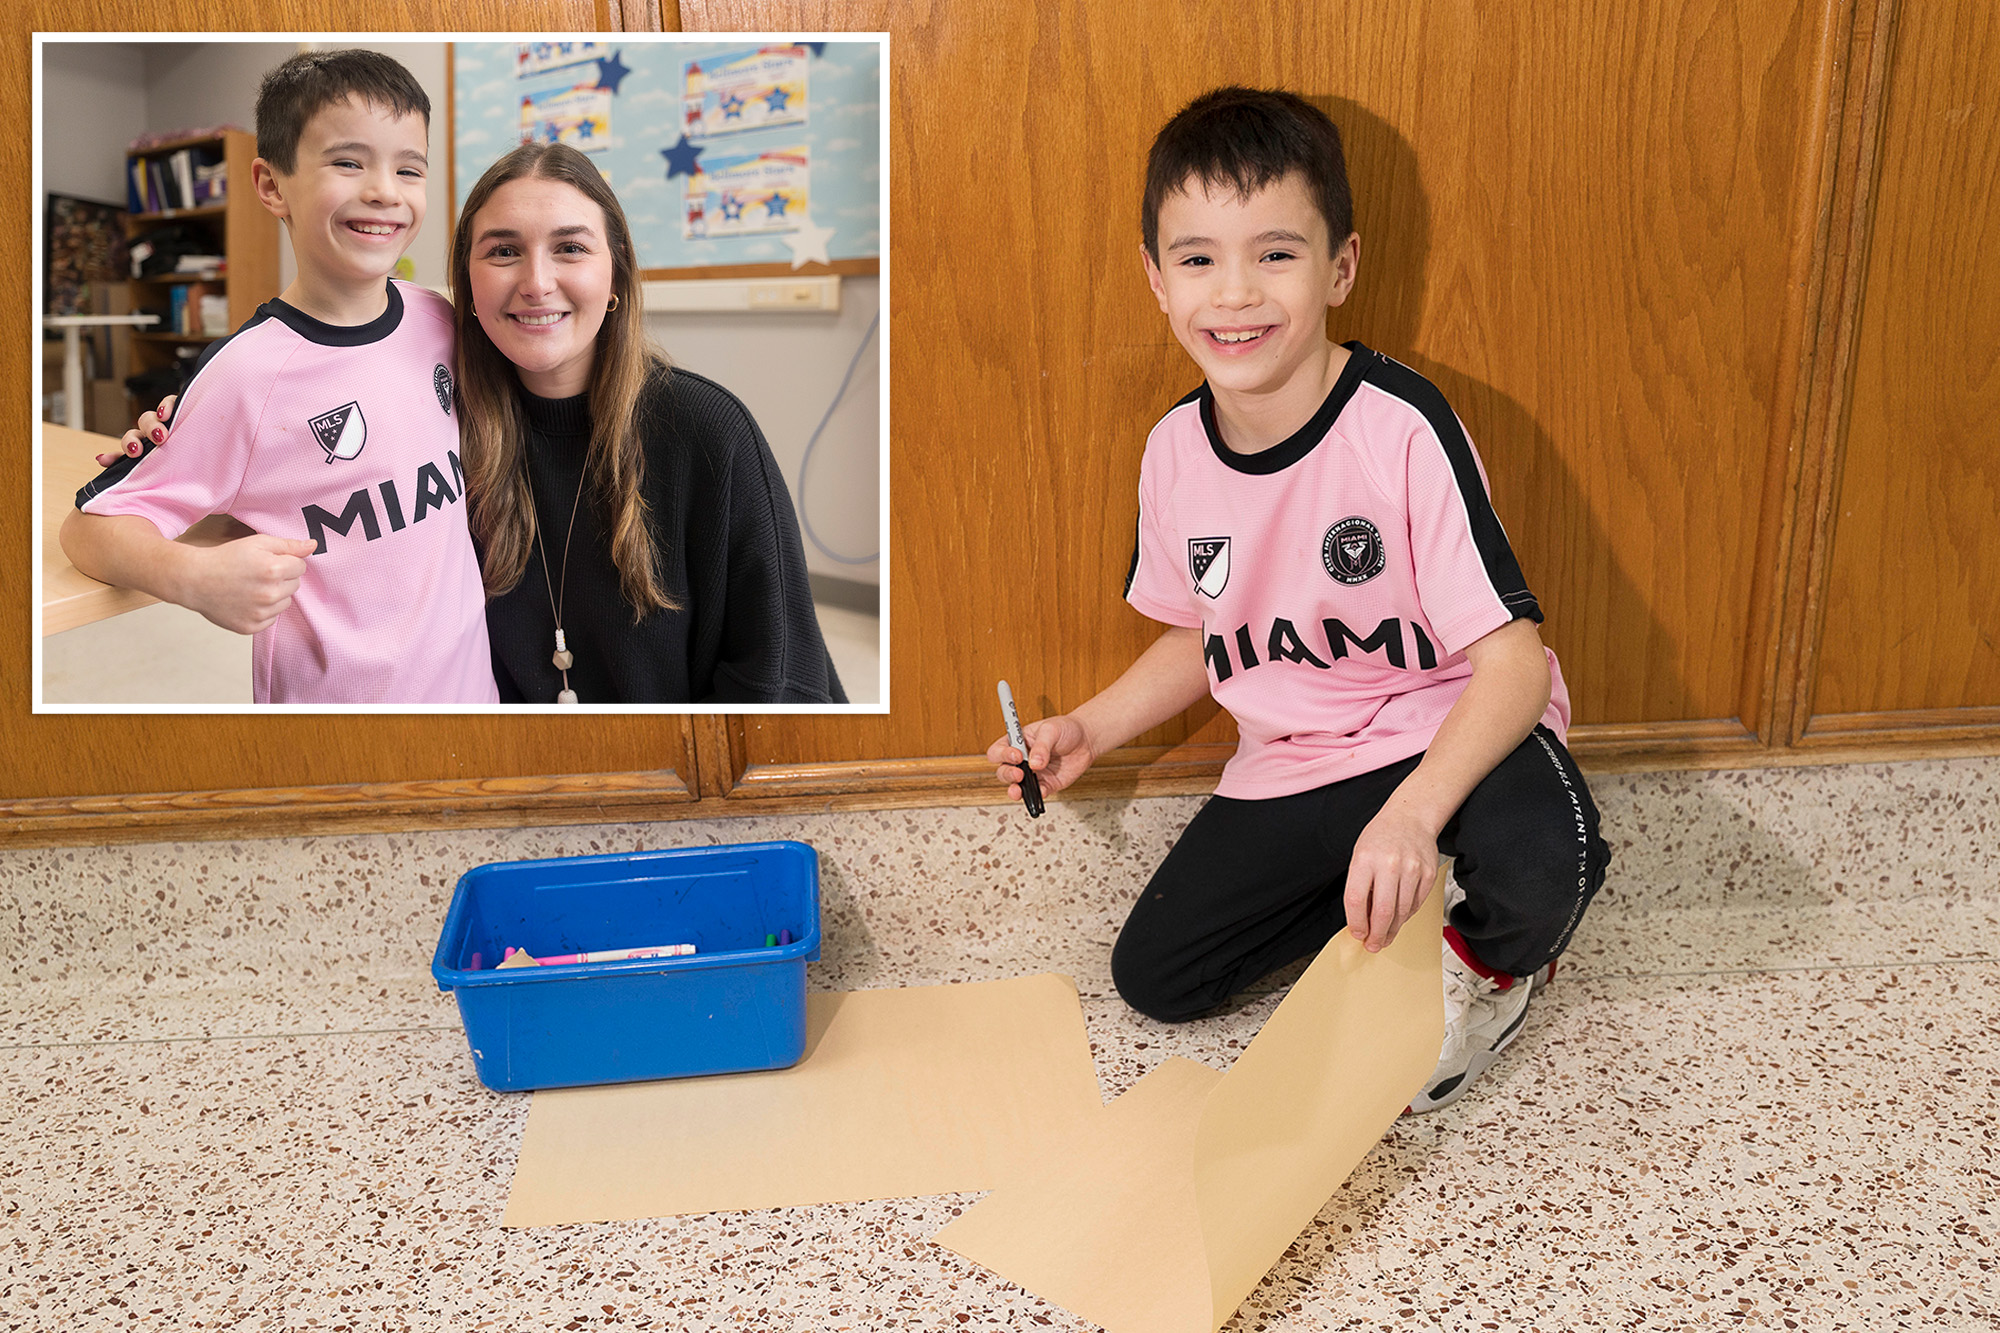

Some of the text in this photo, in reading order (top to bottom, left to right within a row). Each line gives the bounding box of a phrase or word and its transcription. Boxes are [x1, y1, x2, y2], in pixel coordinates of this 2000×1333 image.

[316, 414, 343, 433] MLS
[1341, 535, 1367, 543] MIAMI
[1193, 543, 1215, 557] MLS
[1567, 789, 1587, 845] PATENT
